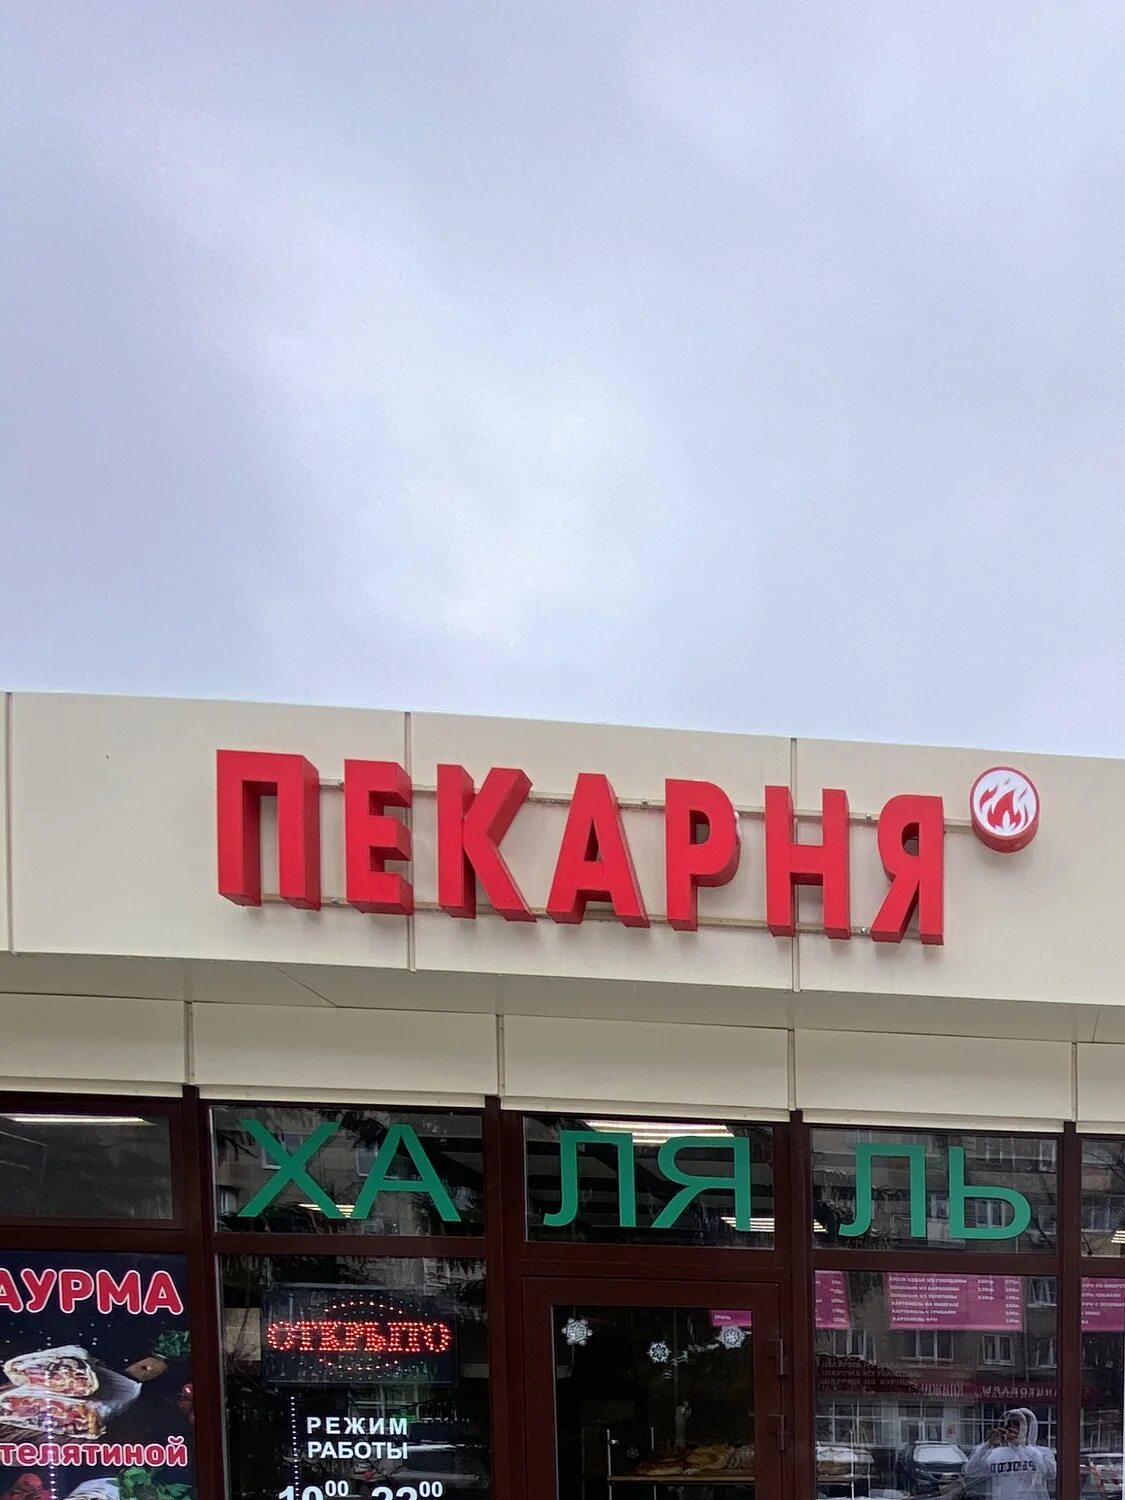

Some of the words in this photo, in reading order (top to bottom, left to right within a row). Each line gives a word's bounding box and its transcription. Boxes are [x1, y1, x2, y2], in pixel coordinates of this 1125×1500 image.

[216, 749, 944, 945] ПЕКАРНЯ
[267, 1320, 453, 1352] ОТКРЫТО
[306, 1416, 408, 1436] РЕЖИМ
[0, 1435, 188, 1467] телятиной
[307, 1441, 408, 1460] РАБОТЫ
